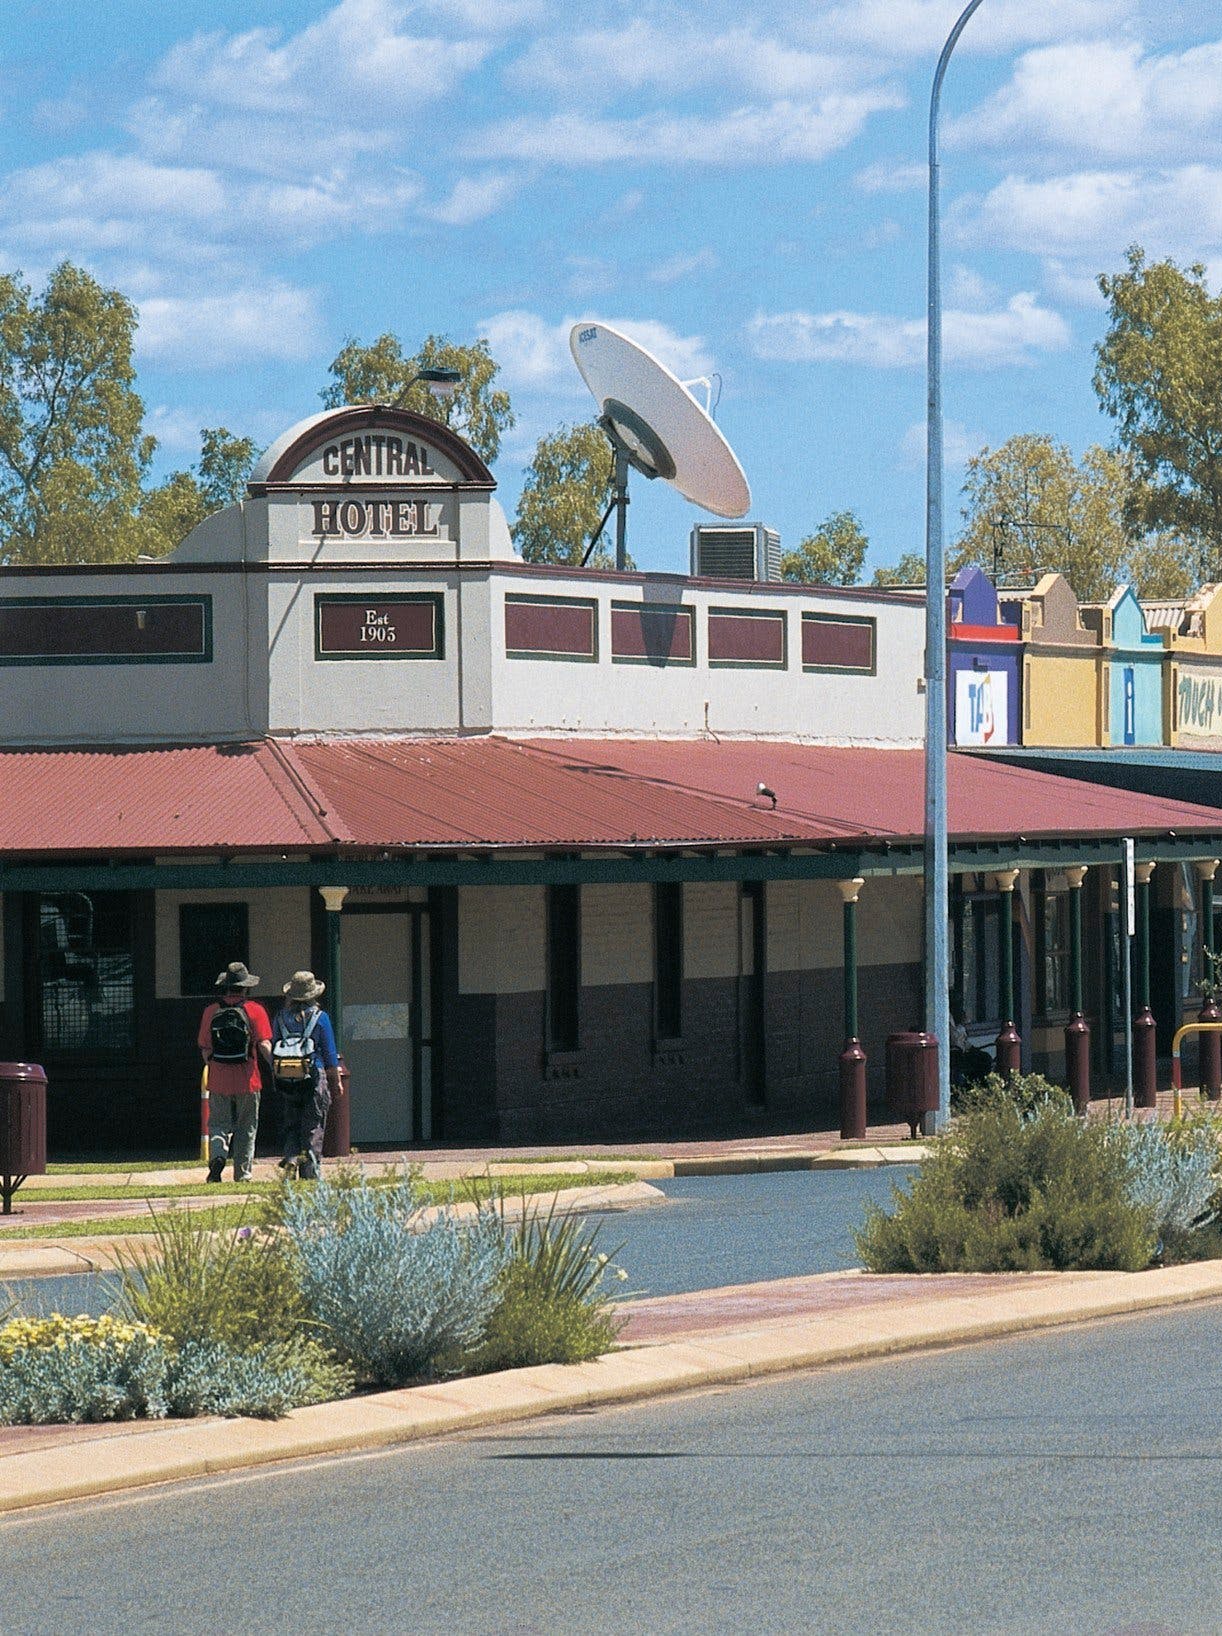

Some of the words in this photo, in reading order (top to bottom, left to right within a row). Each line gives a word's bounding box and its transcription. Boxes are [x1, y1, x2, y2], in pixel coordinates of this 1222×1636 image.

[322, 434, 435, 477] CENTRAL
[310, 499, 440, 539] HOTEL
[365, 609, 390, 625] Est
[1179, 676, 1215, 730] TOUCH
